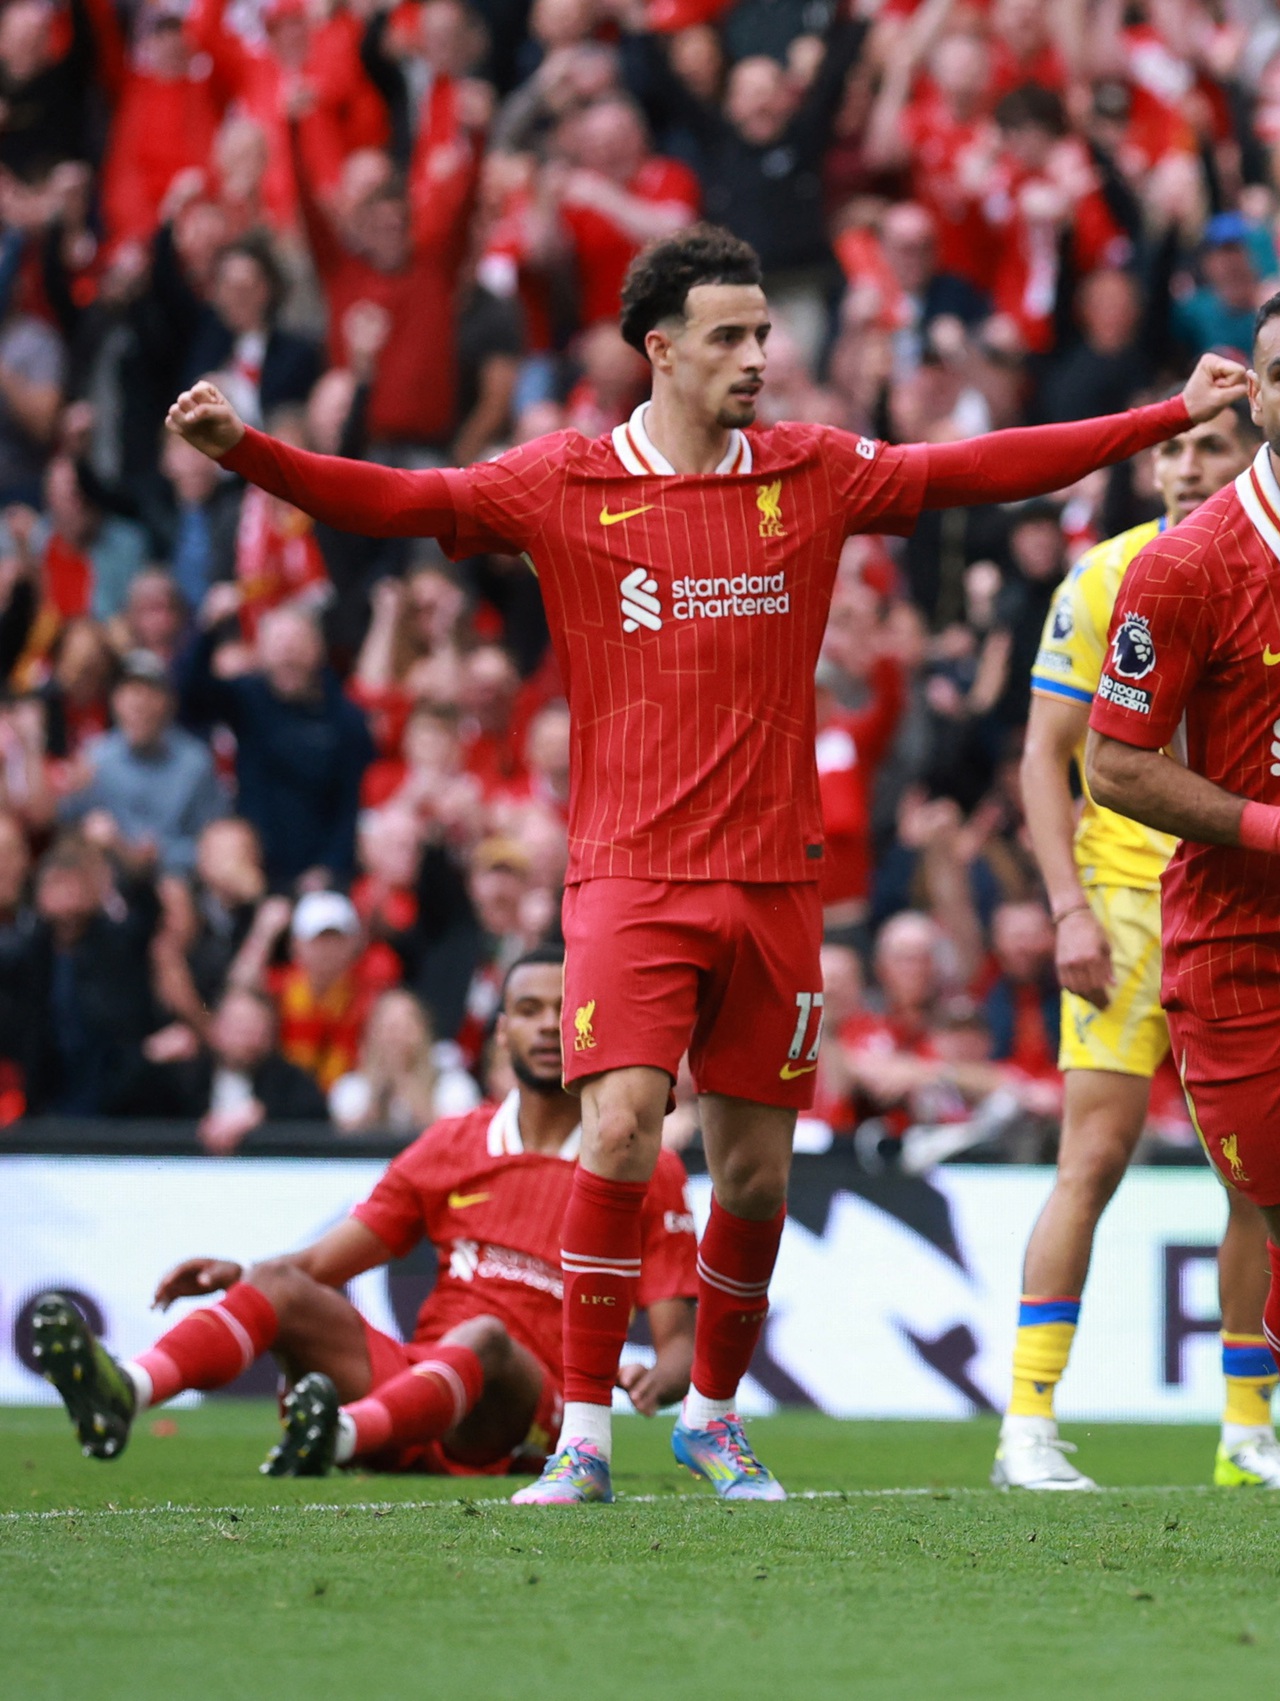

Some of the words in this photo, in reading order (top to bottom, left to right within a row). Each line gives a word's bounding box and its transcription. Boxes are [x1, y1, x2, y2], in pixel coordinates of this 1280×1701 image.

[671, 571, 785, 598] standard
[673, 594, 790, 620] chartered
[1113, 682, 1147, 702] room
[580, 1294, 616, 1306] LFC
